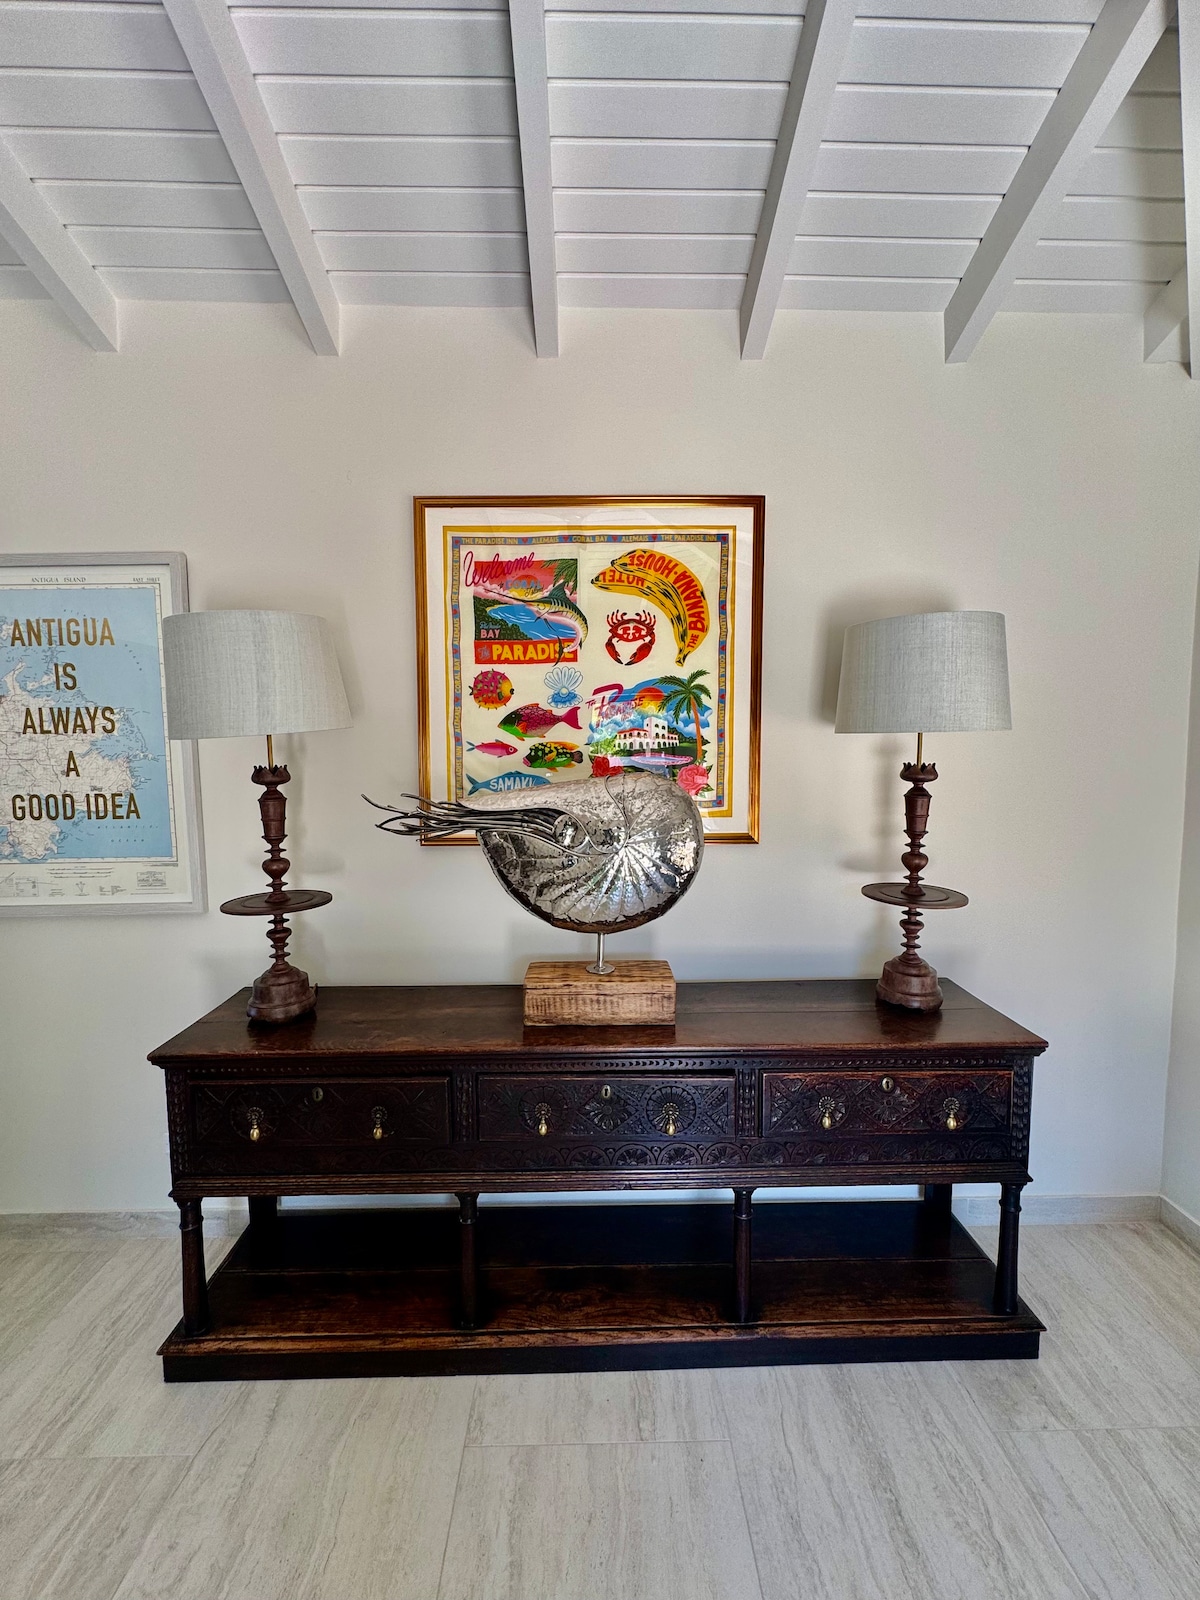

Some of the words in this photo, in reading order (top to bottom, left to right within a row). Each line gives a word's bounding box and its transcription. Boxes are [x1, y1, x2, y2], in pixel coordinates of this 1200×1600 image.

[661, 534, 672, 542] THE
[674, 534, 704, 542] PARADISE
[705, 534, 717, 542] INN
[452, 562, 460, 592] PARADISE
[463, 550, 535, 587] Welcome
[600, 569, 646, 588] HOTEL
[628, 553, 678, 578] HOUSE
[672, 570, 706, 633] BANANA
[10, 618, 115, 646] ANTIGUA
[480, 629, 500, 638] BAY
[687, 634, 700, 648] THE
[54, 662, 77, 691] IS
[22, 706, 116, 734] ALWAYS
[65, 750, 80, 777] A
[12, 794, 76, 820] GOOD
[85, 792, 141, 820] IDEA
